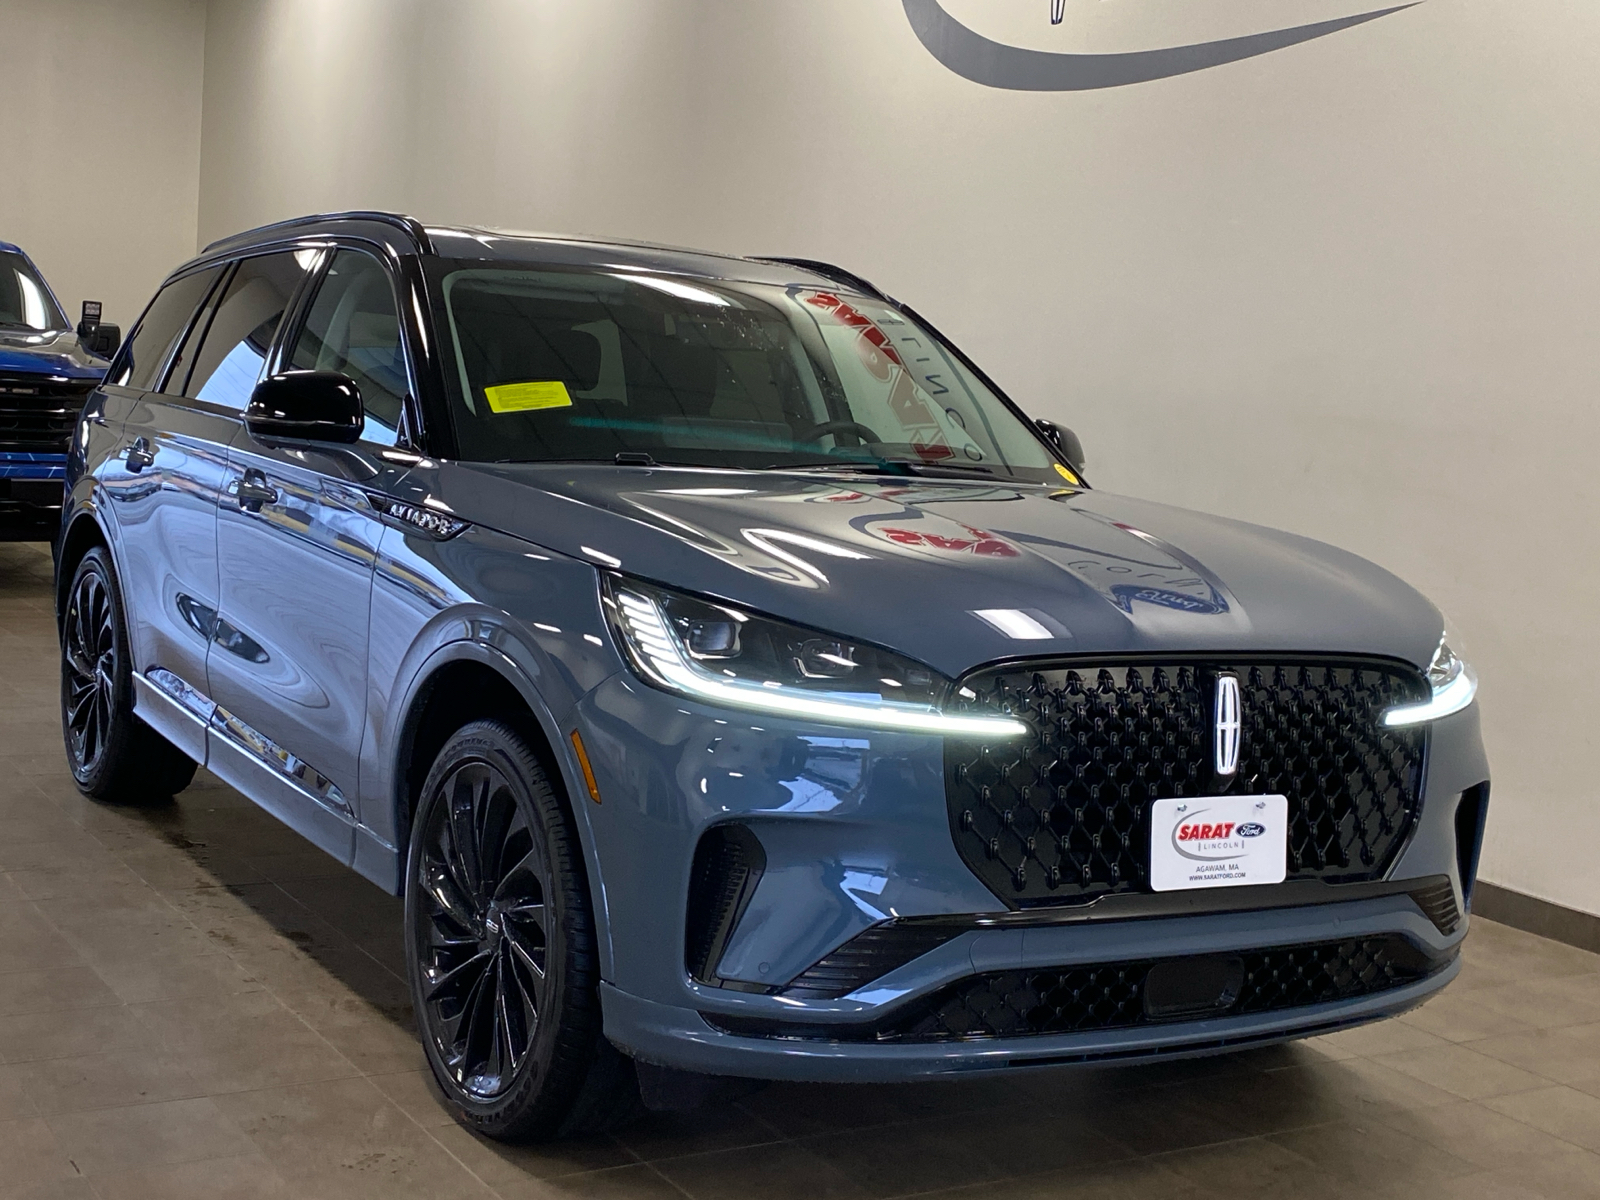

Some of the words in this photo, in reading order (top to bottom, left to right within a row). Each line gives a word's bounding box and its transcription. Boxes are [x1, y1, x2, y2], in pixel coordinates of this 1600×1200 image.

[1177, 822, 1236, 841] SARAT
[1239, 823, 1262, 838] Ford
[1203, 842, 1239, 850] LINCOLN
[1228, 863, 1240, 871] MA
[1188, 872, 1247, 881] WWW.SARATFORD.COM
